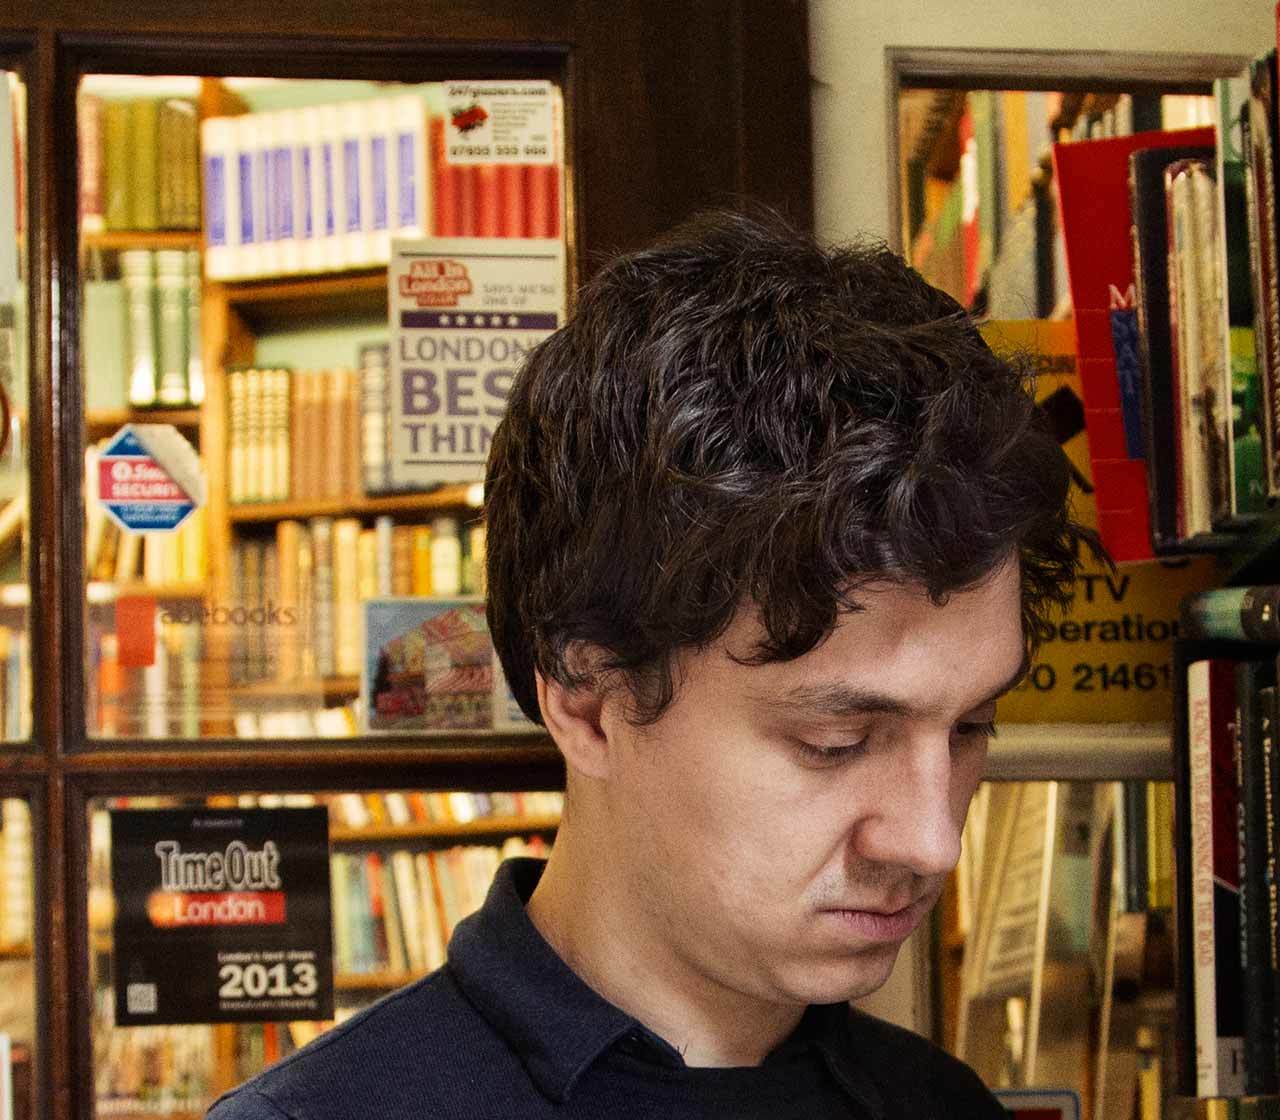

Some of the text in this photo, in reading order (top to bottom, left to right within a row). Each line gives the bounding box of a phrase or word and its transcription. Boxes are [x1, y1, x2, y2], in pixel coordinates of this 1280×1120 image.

[402, 368, 517, 418] BES
[401, 423, 494, 454] THIN
[1038, 611, 1179, 645] peratio
[154, 840, 281, 891] Time Out
[174, 898, 267, 922] London
[218, 962, 319, 999] 2013
